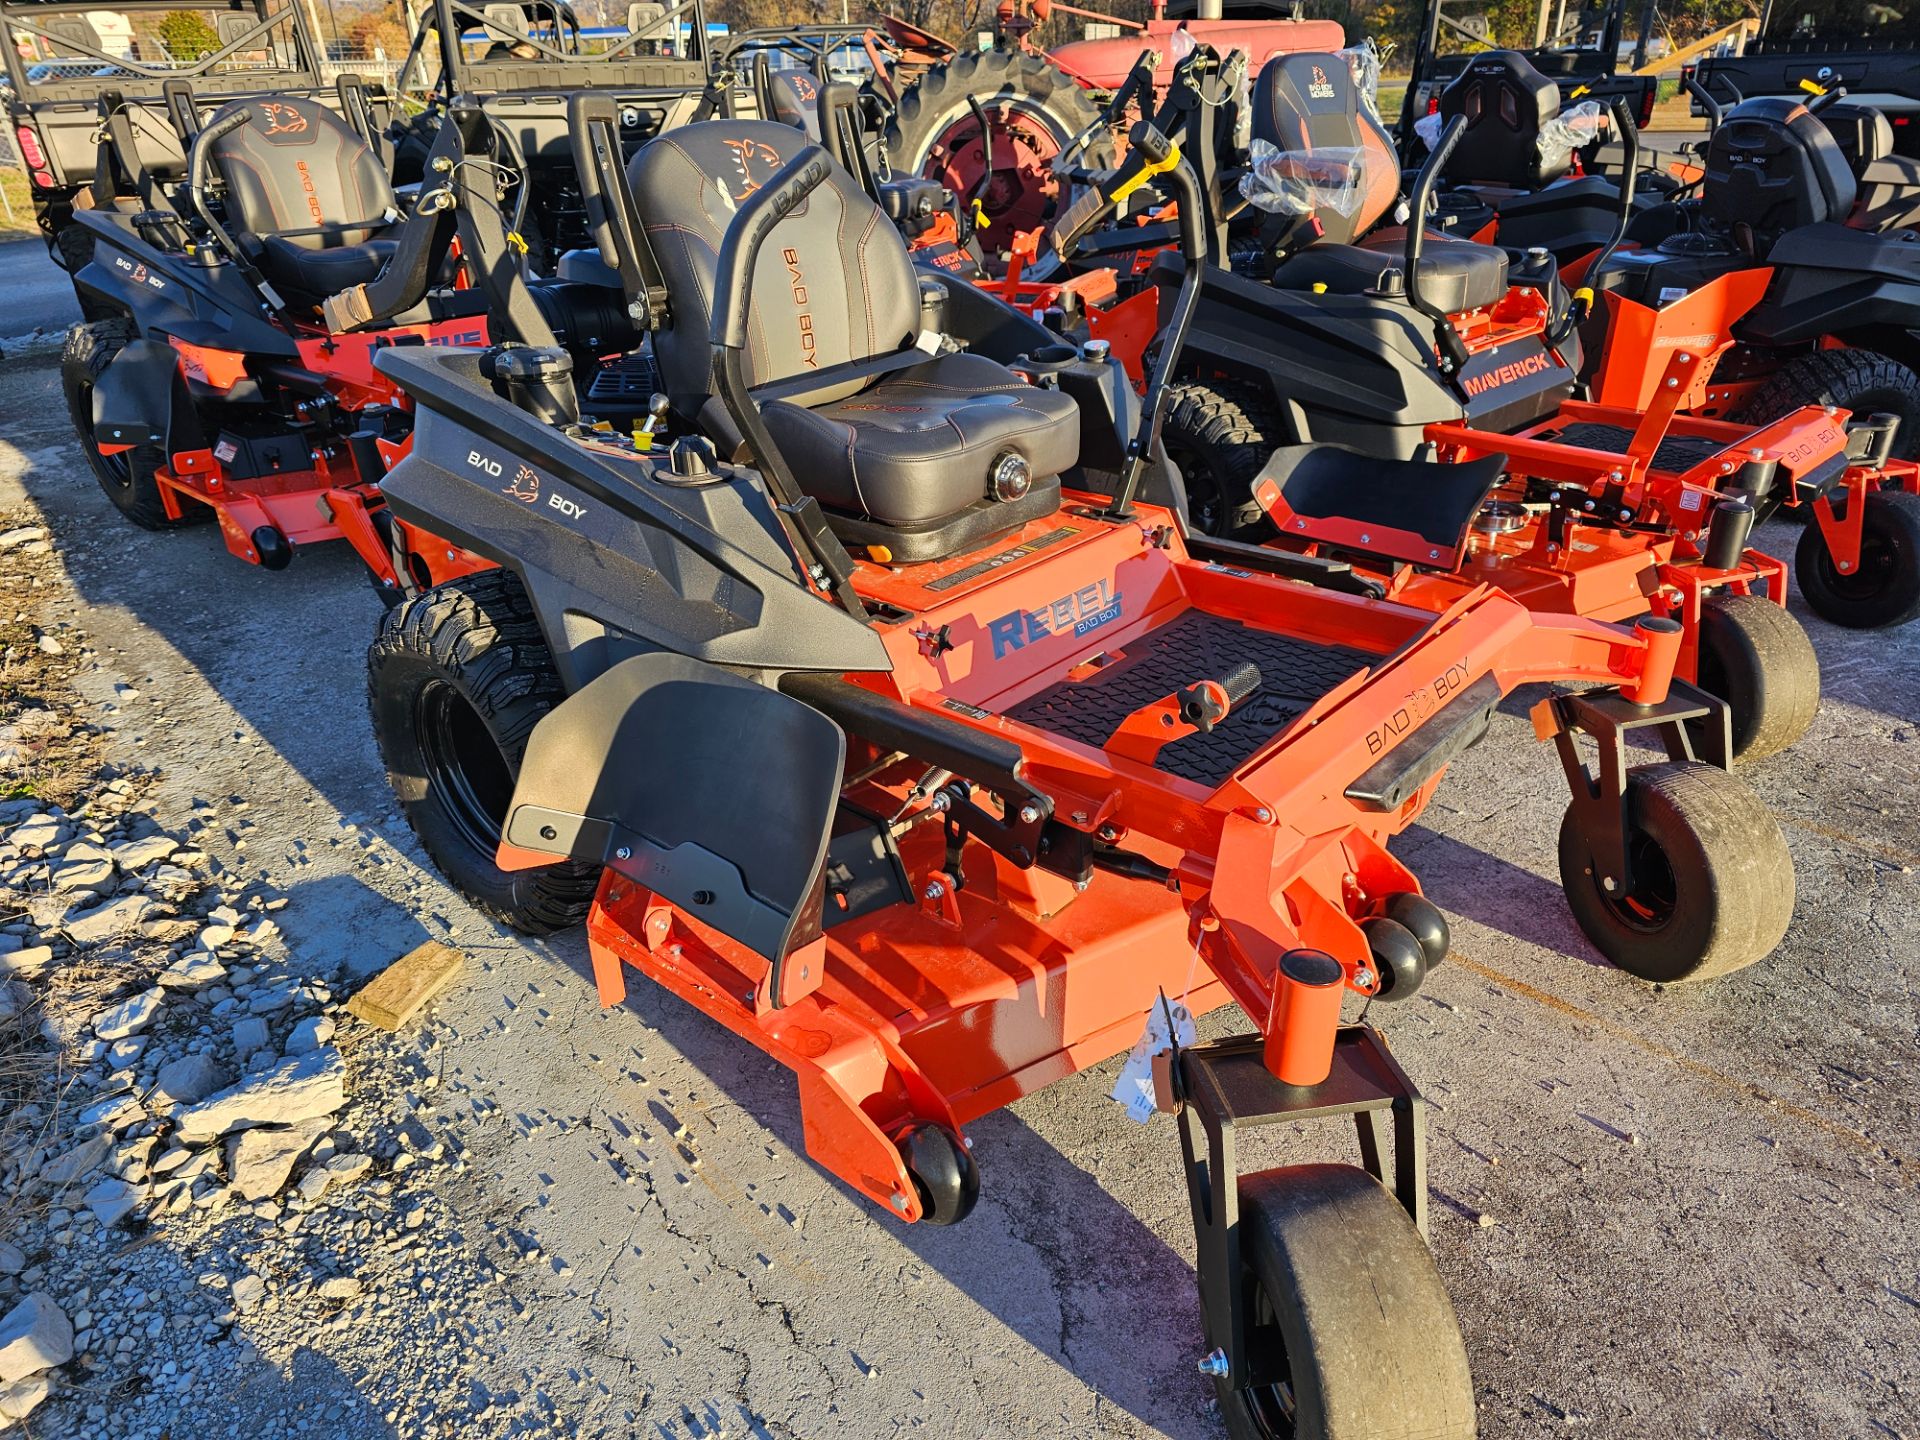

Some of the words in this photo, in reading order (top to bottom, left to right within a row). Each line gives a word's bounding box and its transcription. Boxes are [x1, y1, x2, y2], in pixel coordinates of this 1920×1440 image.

[1311, 90, 1335, 98] MOWERS
[296, 160, 315, 193] BAD
[308, 196, 325, 227] BOY
[771, 162, 823, 216] BAD
[115, 257, 132, 271] BAD
[148, 276, 166, 289] BOY
[930, 251, 962, 267] ERICK
[950, 262, 961, 271] HD
[782, 247, 809, 305] BAD
[798, 313, 819, 368] BOY
[1464, 352, 1551, 396] MAVERICK
[1787, 443, 1813, 463] BAD
[1817, 425, 1840, 444] BOY
[467, 450, 502, 472] BAD
[548, 493, 588, 520] BOY
[986, 577, 1123, 661] REBEL
[1077, 616, 1098, 634] BAD
[1099, 606, 1119, 623] BOY
[1365, 709, 1410, 757] BAD
[1433, 655, 1469, 700] BOY
